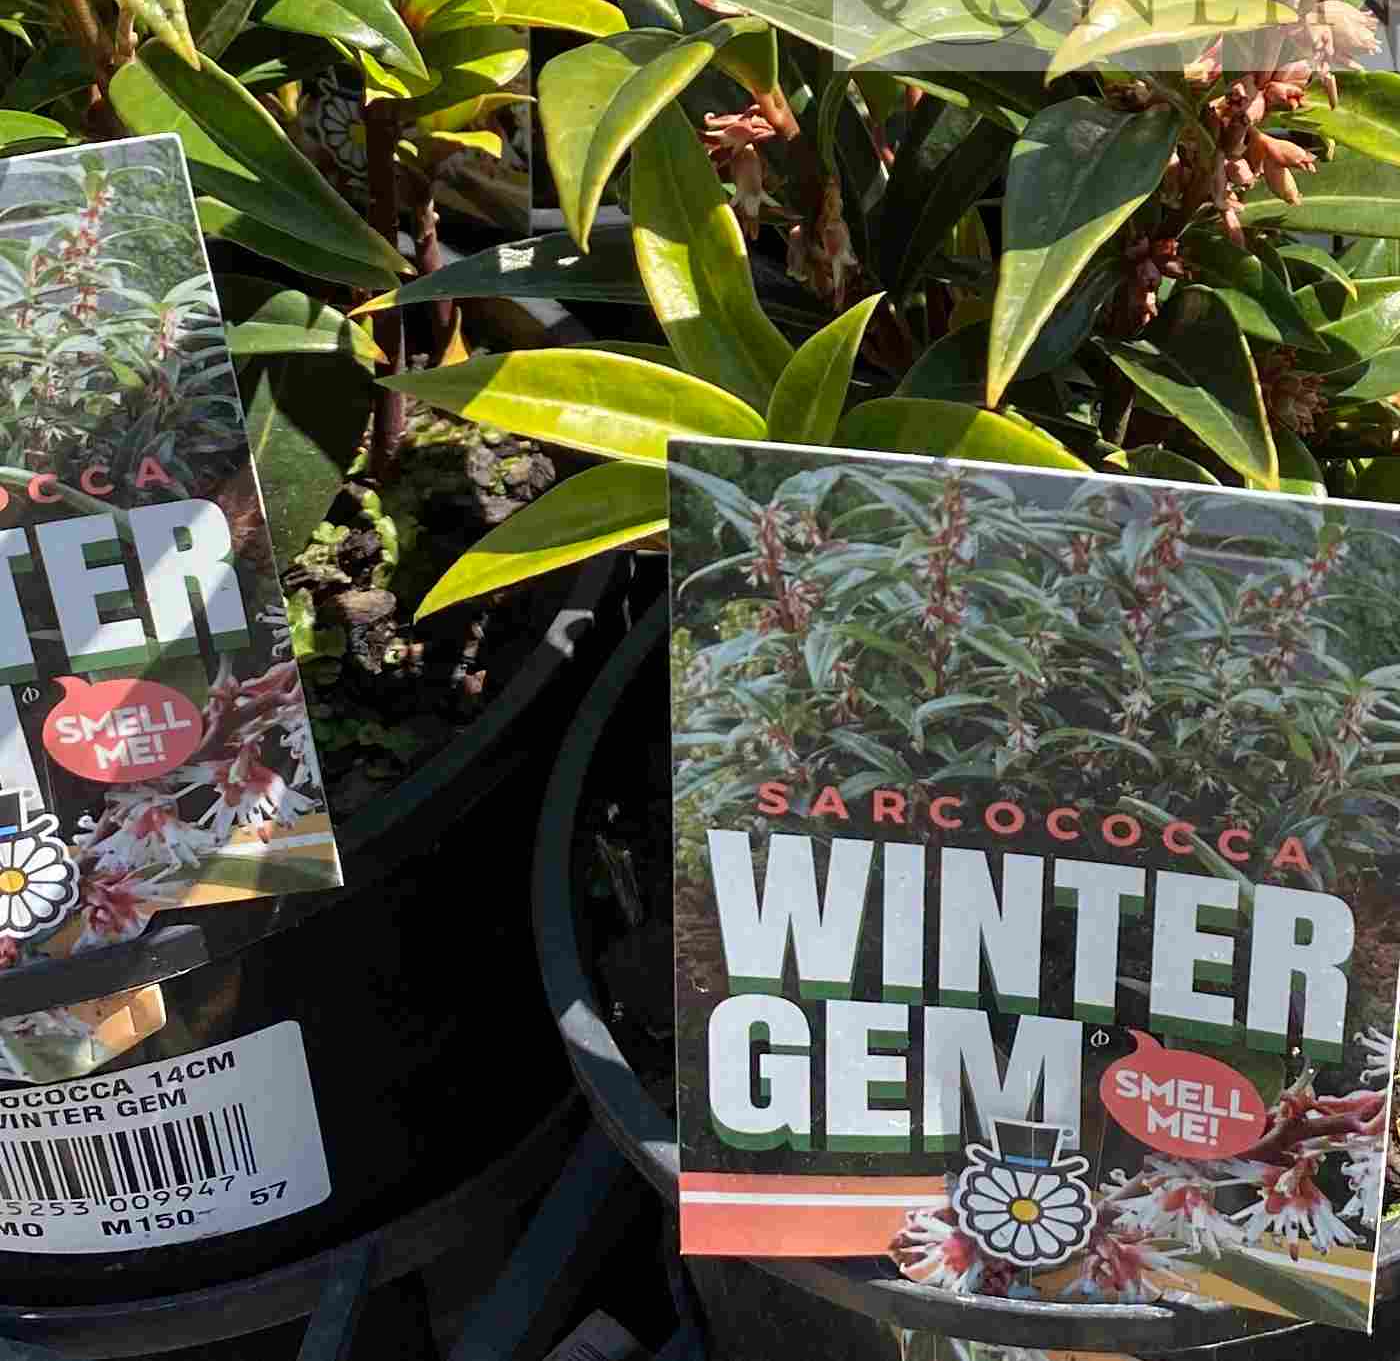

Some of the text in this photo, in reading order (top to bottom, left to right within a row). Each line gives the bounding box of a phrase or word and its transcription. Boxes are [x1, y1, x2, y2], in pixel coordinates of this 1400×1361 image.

[0, 456, 177, 512] CCA
[55, 701, 192, 744] SMELL
[93, 734, 167, 770] ME!
[757, 782, 1312, 871] SARCOCOCCA
[707, 828, 1355, 1044] WINTER
[148, 1050, 236, 1088] 14CM
[707, 993, 1083, 1151] GEM
[117, 1088, 188, 1117] GEM
[1115, 1068, 1255, 1123] SMELL
[1146, 1105, 1221, 1146] ME!
[0, 1175, 288, 1217] 5253 009947 57
[101, 1209, 196, 1237] M150
